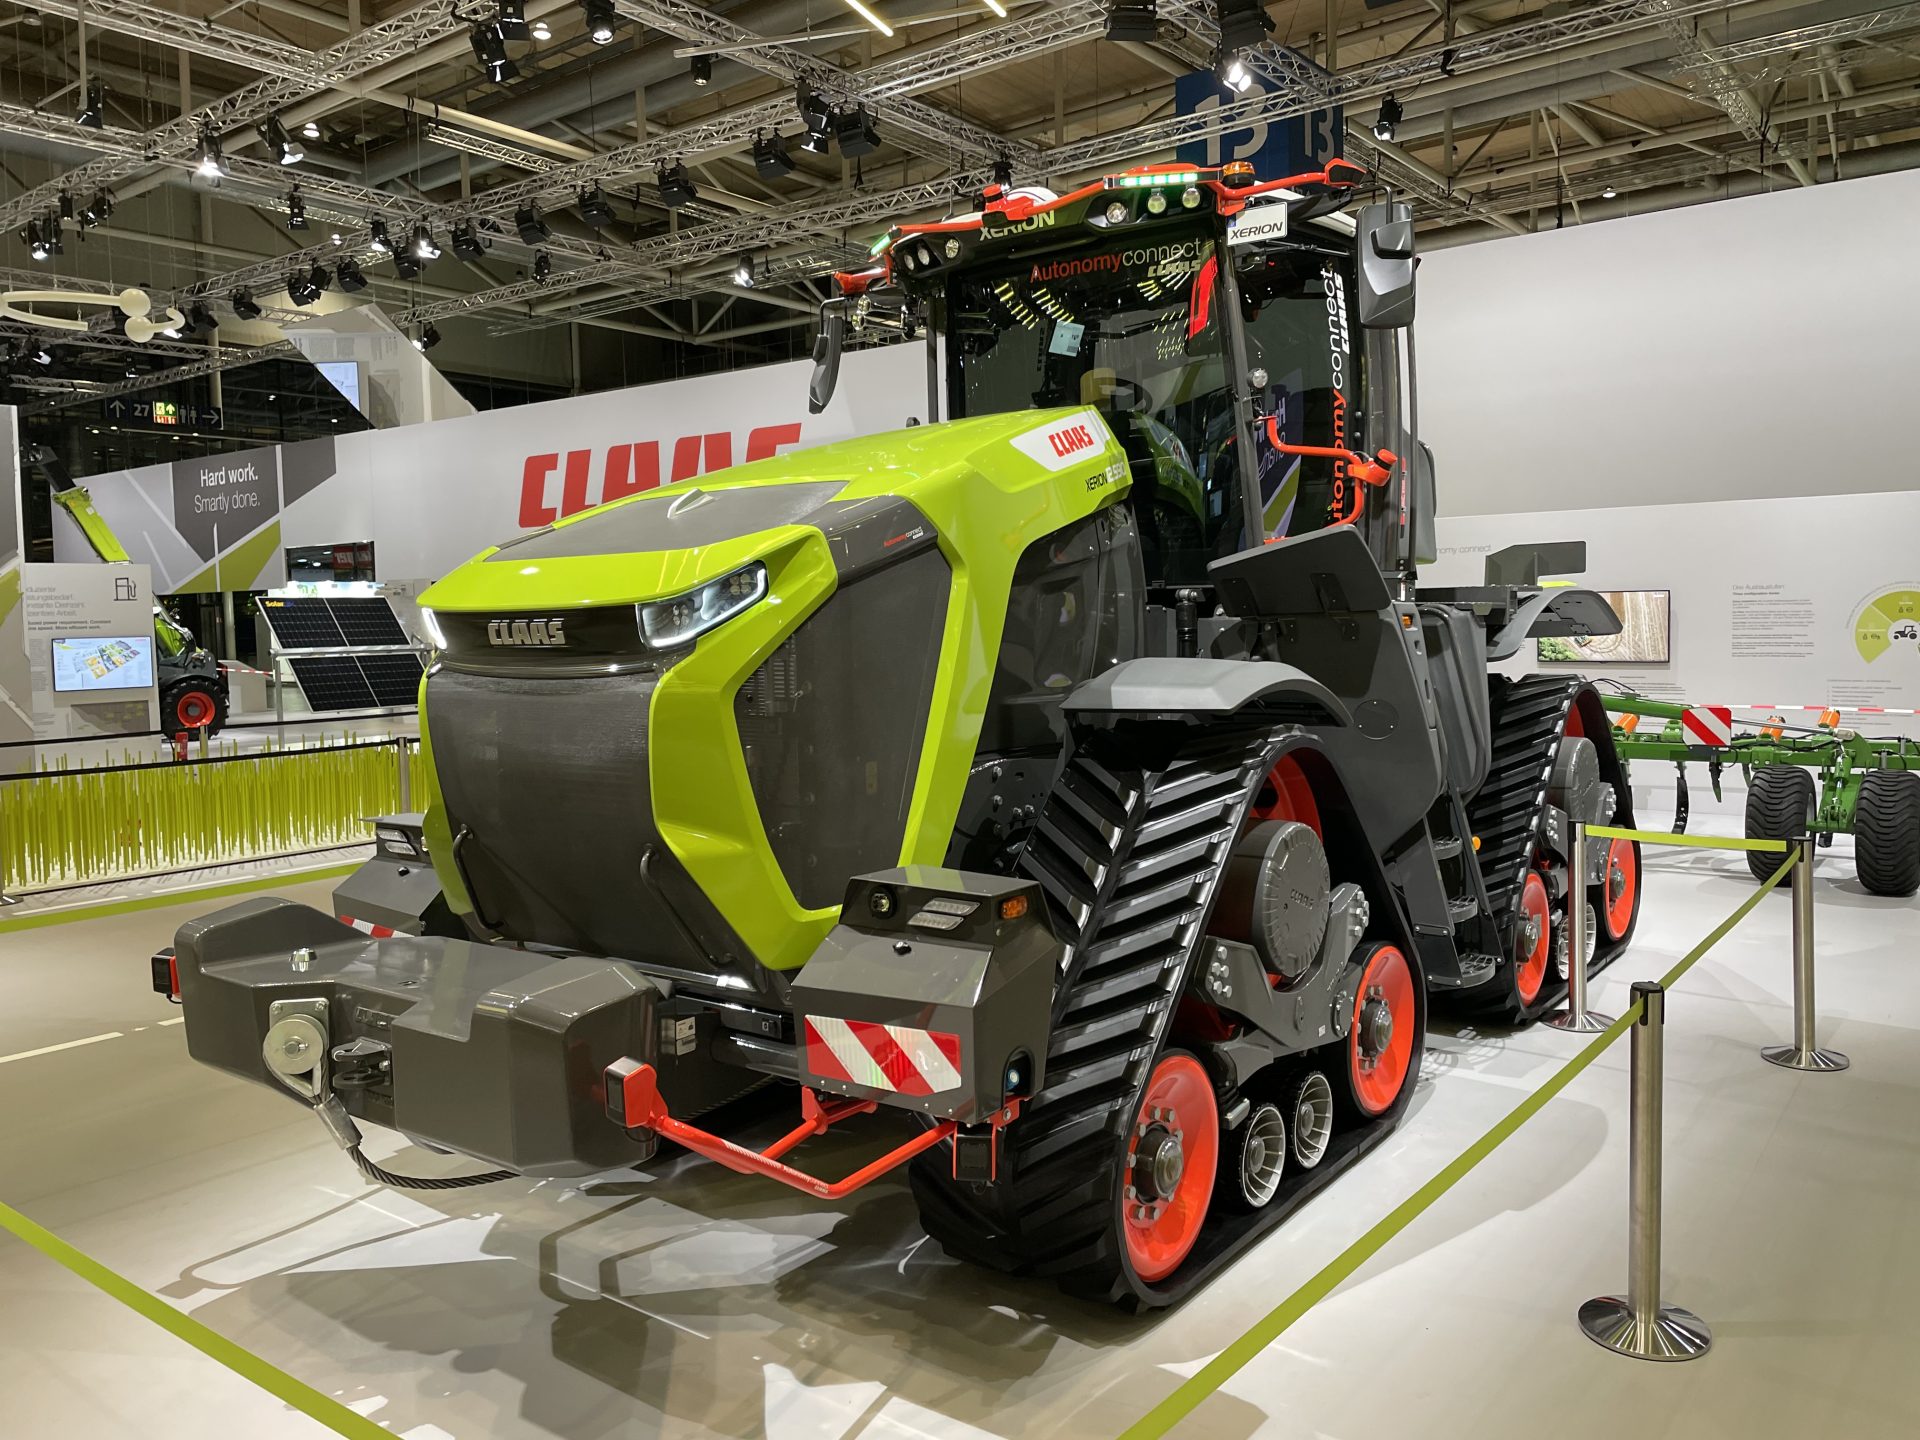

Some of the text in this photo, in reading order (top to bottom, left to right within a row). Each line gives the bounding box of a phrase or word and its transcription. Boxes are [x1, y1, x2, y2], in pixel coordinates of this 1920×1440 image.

[1194, 83, 1269, 166] 13
[1230, 222, 1283, 240] XERION
[1334, 272, 1350, 355] CLAAS
[133, 403, 150, 417] 27
[1048, 424, 1095, 458] CLAAS
[200, 462, 259, 488] Hard work.
[1084, 472, 1108, 493] XERION
[194, 489, 261, 514] Smartly done.
[488, 619, 566, 645] CLAAS
